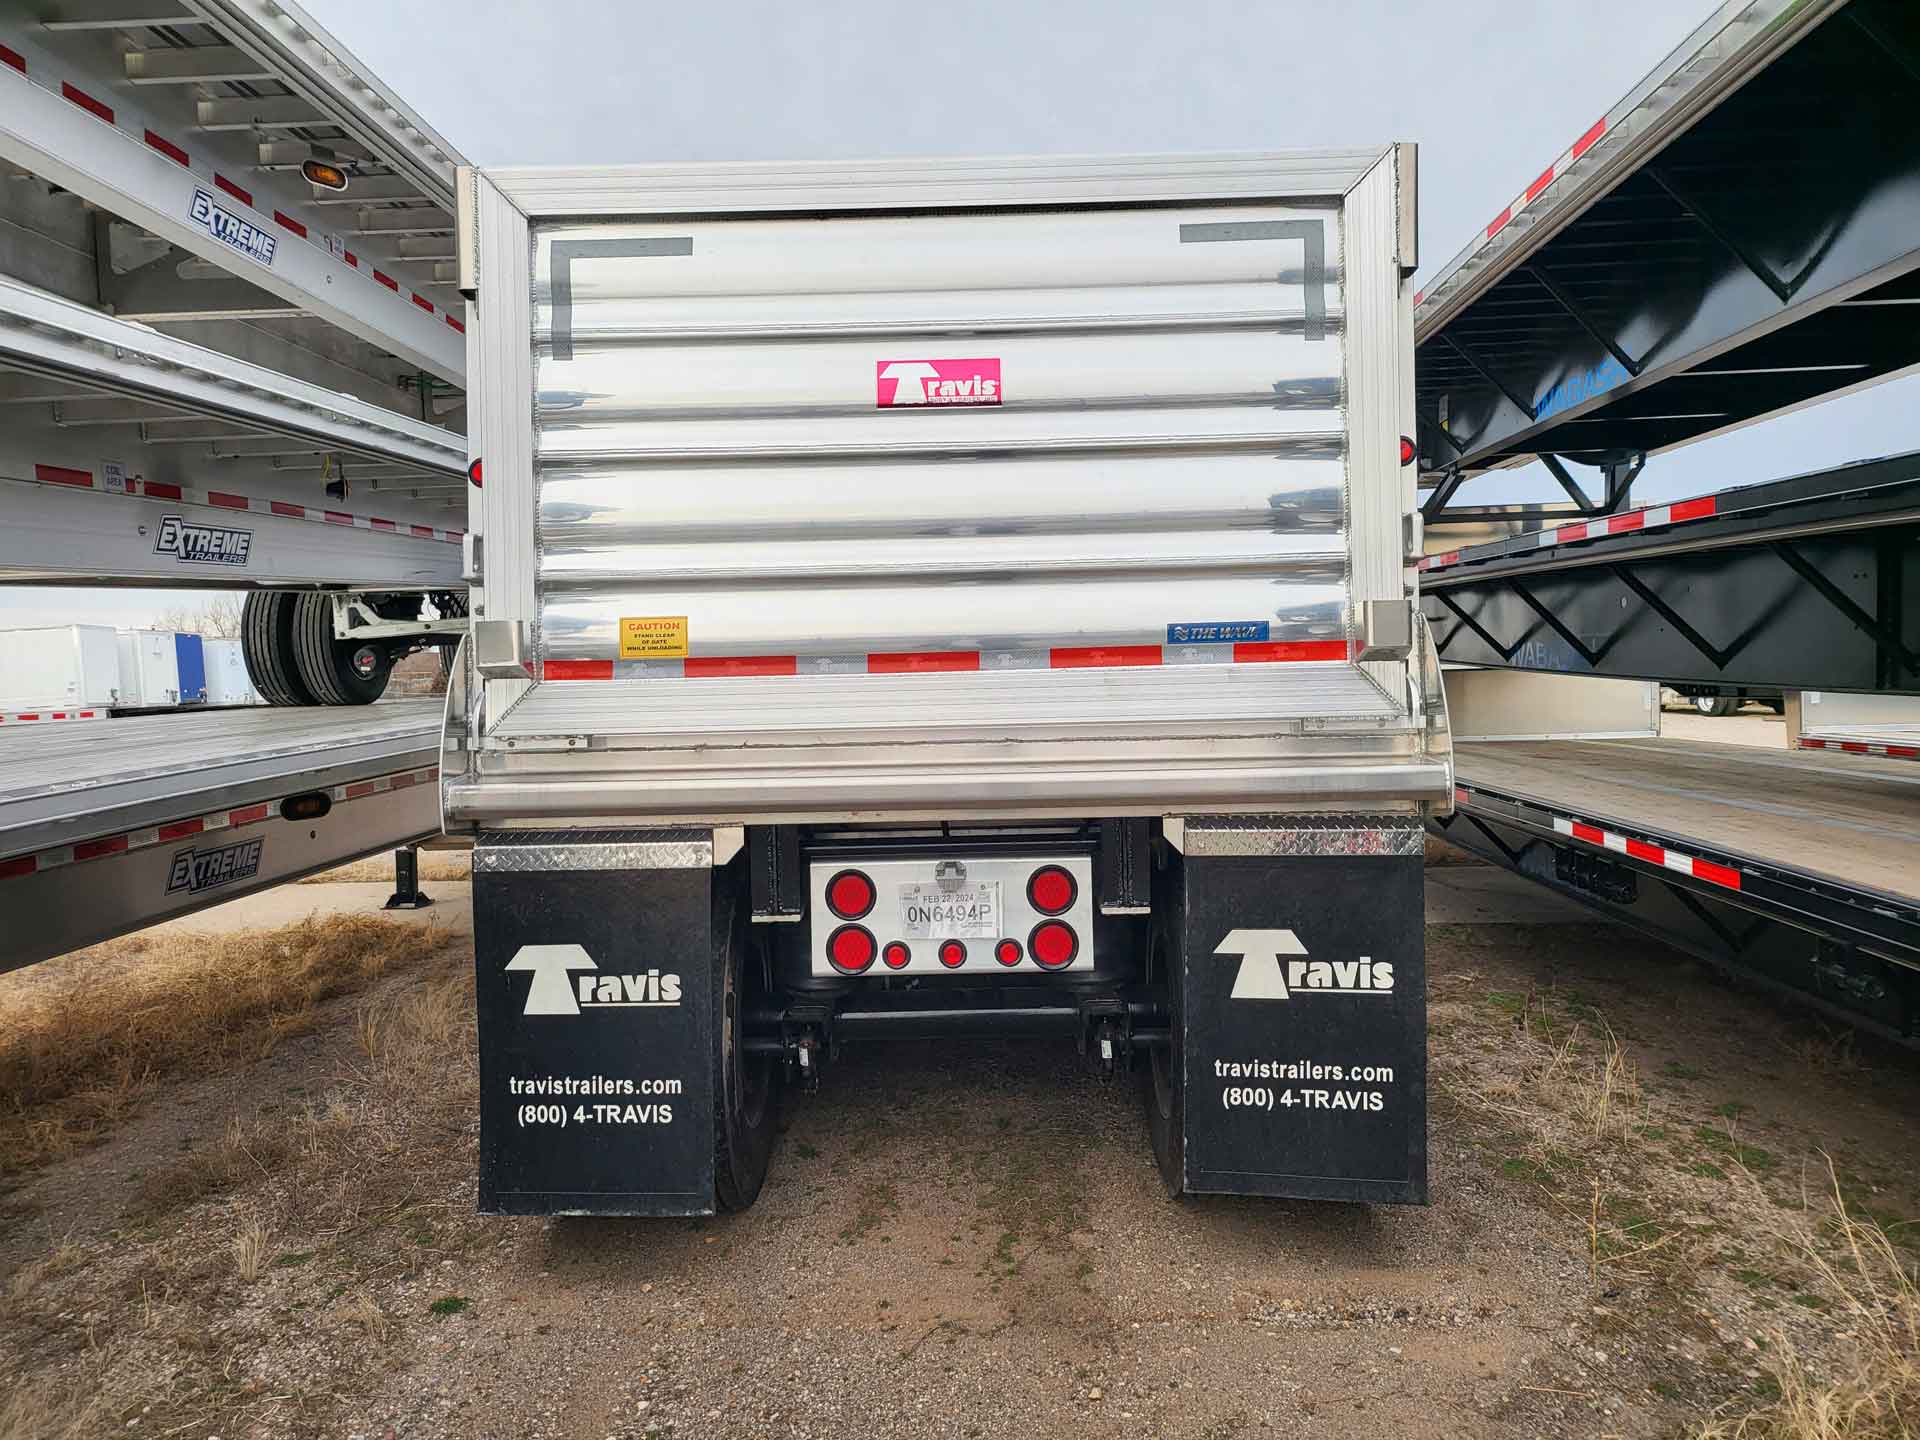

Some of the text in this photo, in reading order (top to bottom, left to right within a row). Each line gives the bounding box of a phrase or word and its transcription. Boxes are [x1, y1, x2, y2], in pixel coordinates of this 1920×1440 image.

[190, 188, 277, 258] EXTREME
[219, 231, 271, 266] TRAILERS
[879, 361, 997, 405] Travis
[158, 519, 250, 558] EXTREME
[188, 551, 245, 563] TRAILERS
[628, 622, 681, 631] CAUTION
[1190, 627, 1217, 639] THE
[170, 840, 261, 889] EXTREME
[923, 895, 940, 903] FEB
[955, 893, 974, 903] 2024
[1212, 929, 1395, 1000] Travis
[504, 943, 683, 1015] Travis
[1214, 1058, 1394, 1083] travistrailers.com
[509, 1075, 682, 1095] travistrailers.com
[1222, 1087, 1384, 1111] (800) 4-TRAVIS
[517, 1104, 673, 1128] (800) 4-TRAVIS
